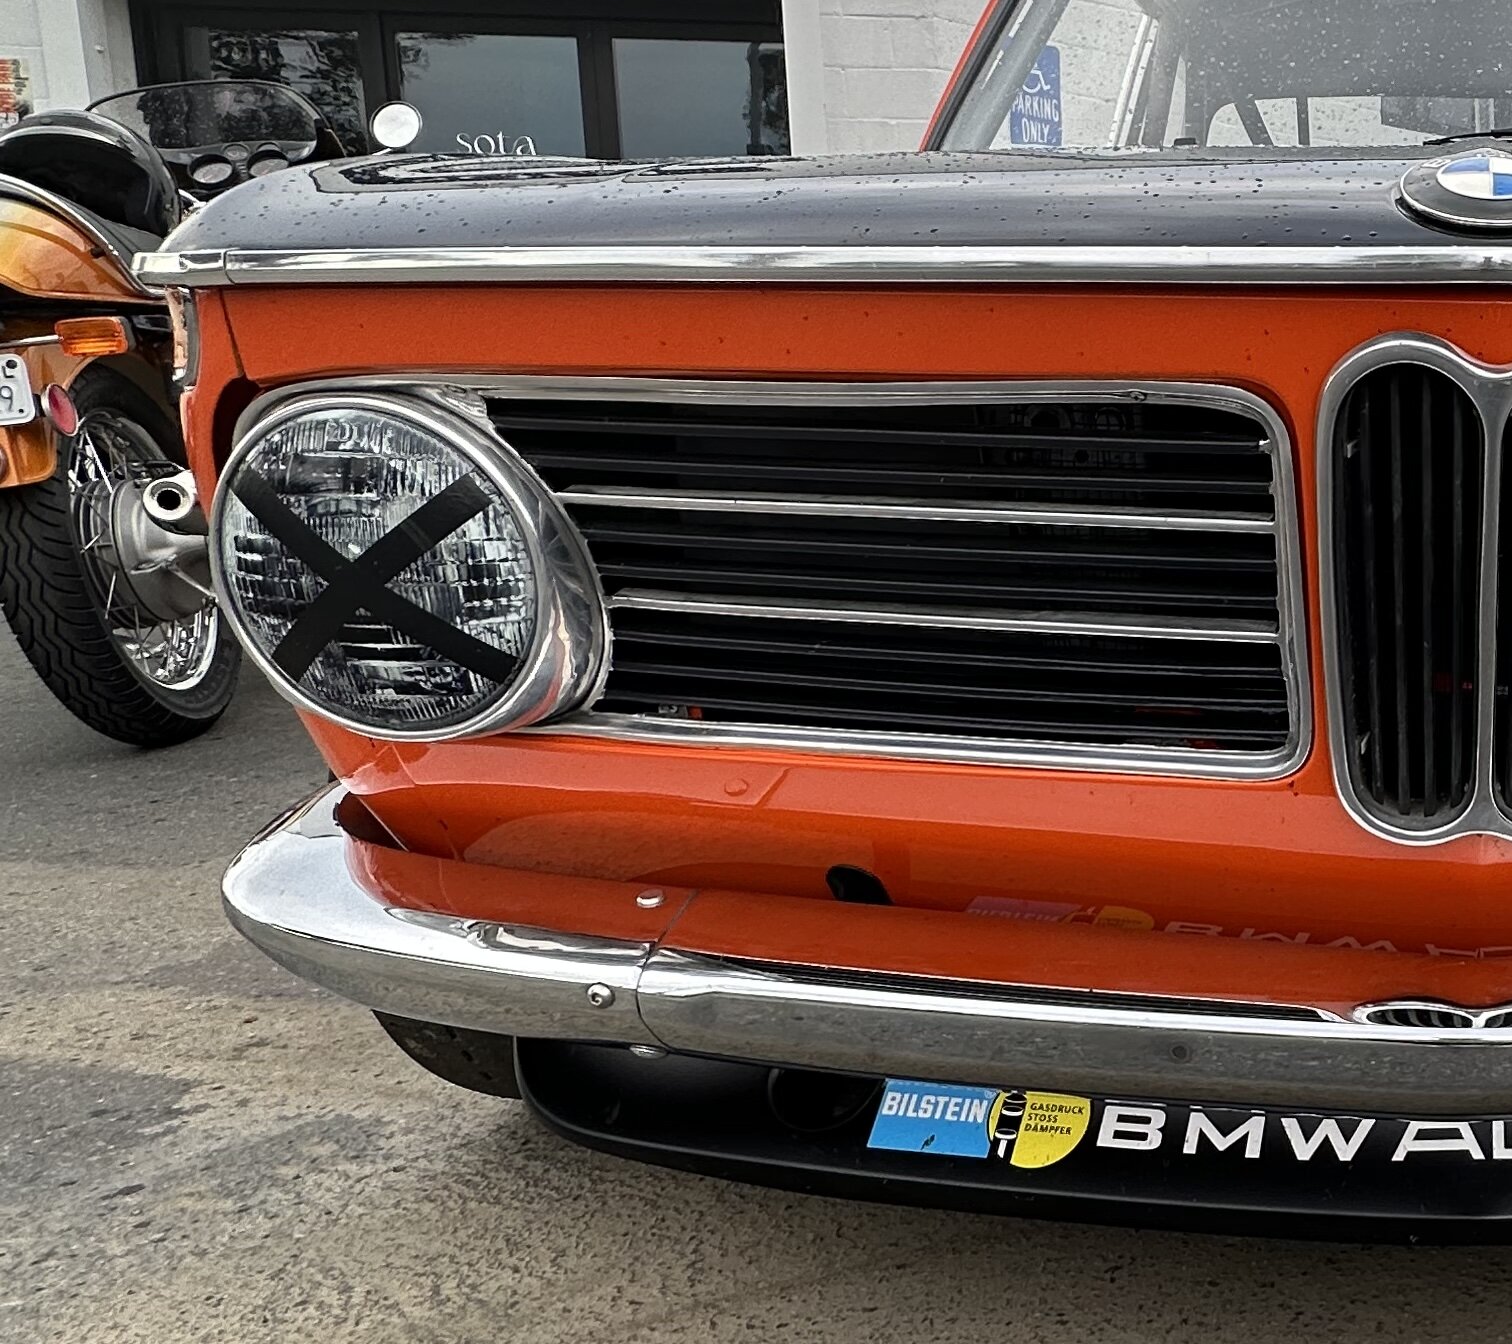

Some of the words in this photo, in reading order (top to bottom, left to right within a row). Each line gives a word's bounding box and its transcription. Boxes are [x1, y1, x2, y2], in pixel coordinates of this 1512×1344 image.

[1012, 94, 1059, 122] PARKING
[1021, 119, 1050, 144] ONLY
[882, 1091, 989, 1124] BILSTEIN
[1027, 1112, 1058, 1123] STOSS
[1030, 1102, 1085, 1115] GASDRUCK
[1096, 1102, 1377, 1161] BMW
